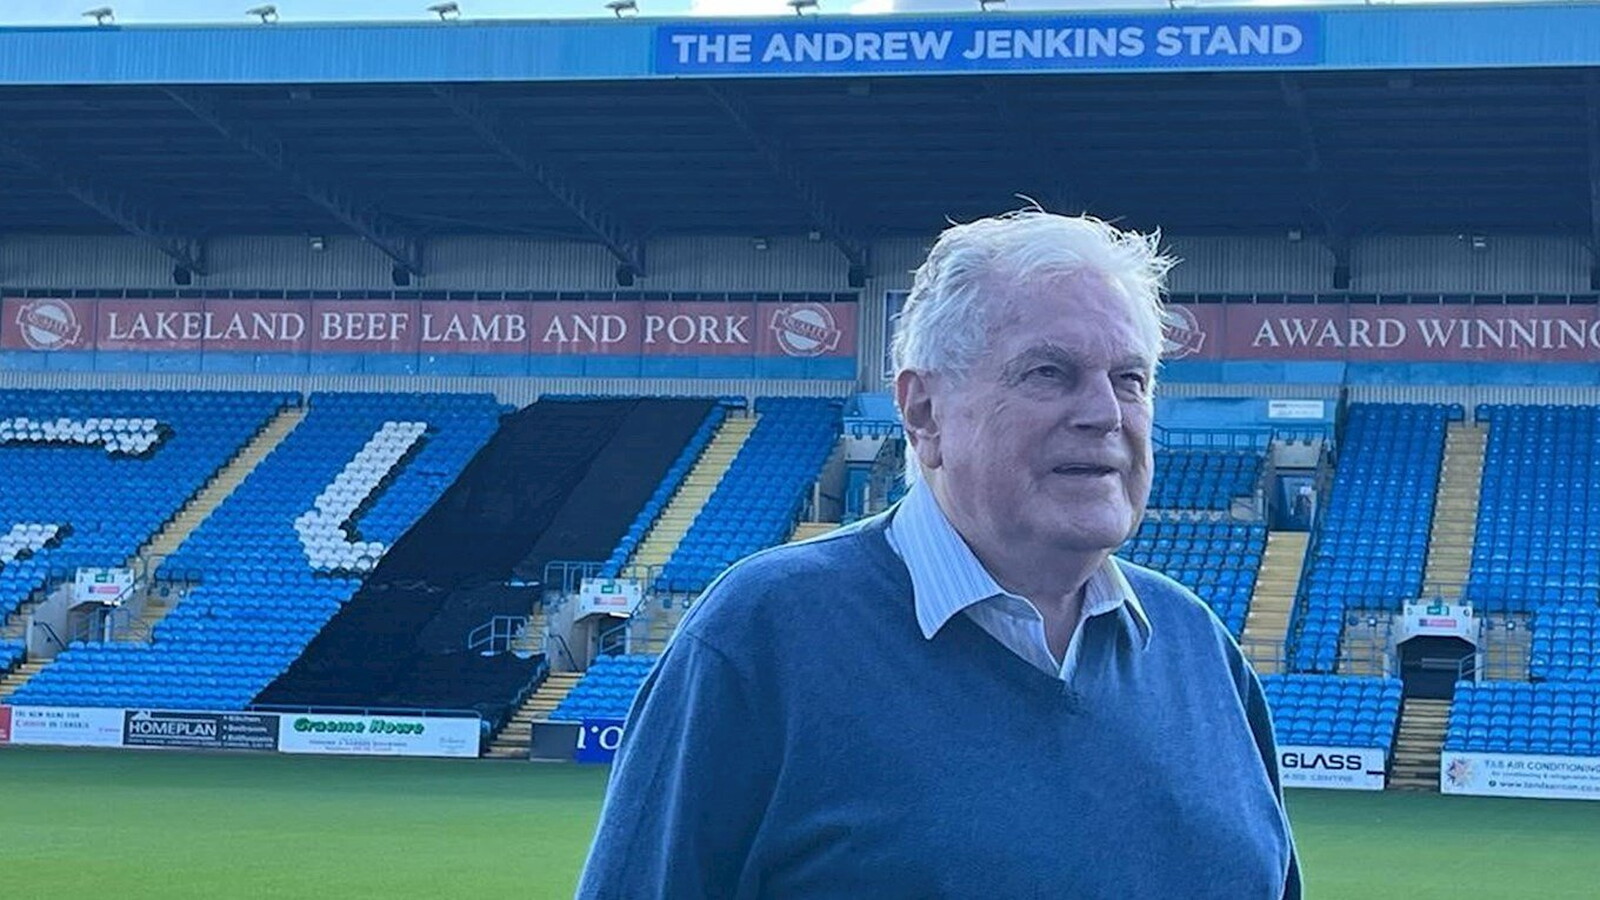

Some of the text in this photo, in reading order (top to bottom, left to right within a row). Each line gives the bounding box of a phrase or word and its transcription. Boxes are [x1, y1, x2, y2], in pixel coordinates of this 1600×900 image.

[672, 24, 1303, 64] THE ANDREW JENKINS STAND
[109, 312, 749, 345] LAKELAND BEEF LAMB AND PORK
[1253, 317, 1406, 348] AWARD
[129, 720, 218, 737] HOMEPLAN
[294, 717, 424, 735] Graeme Howe
[1281, 752, 1361, 770] GLASS
